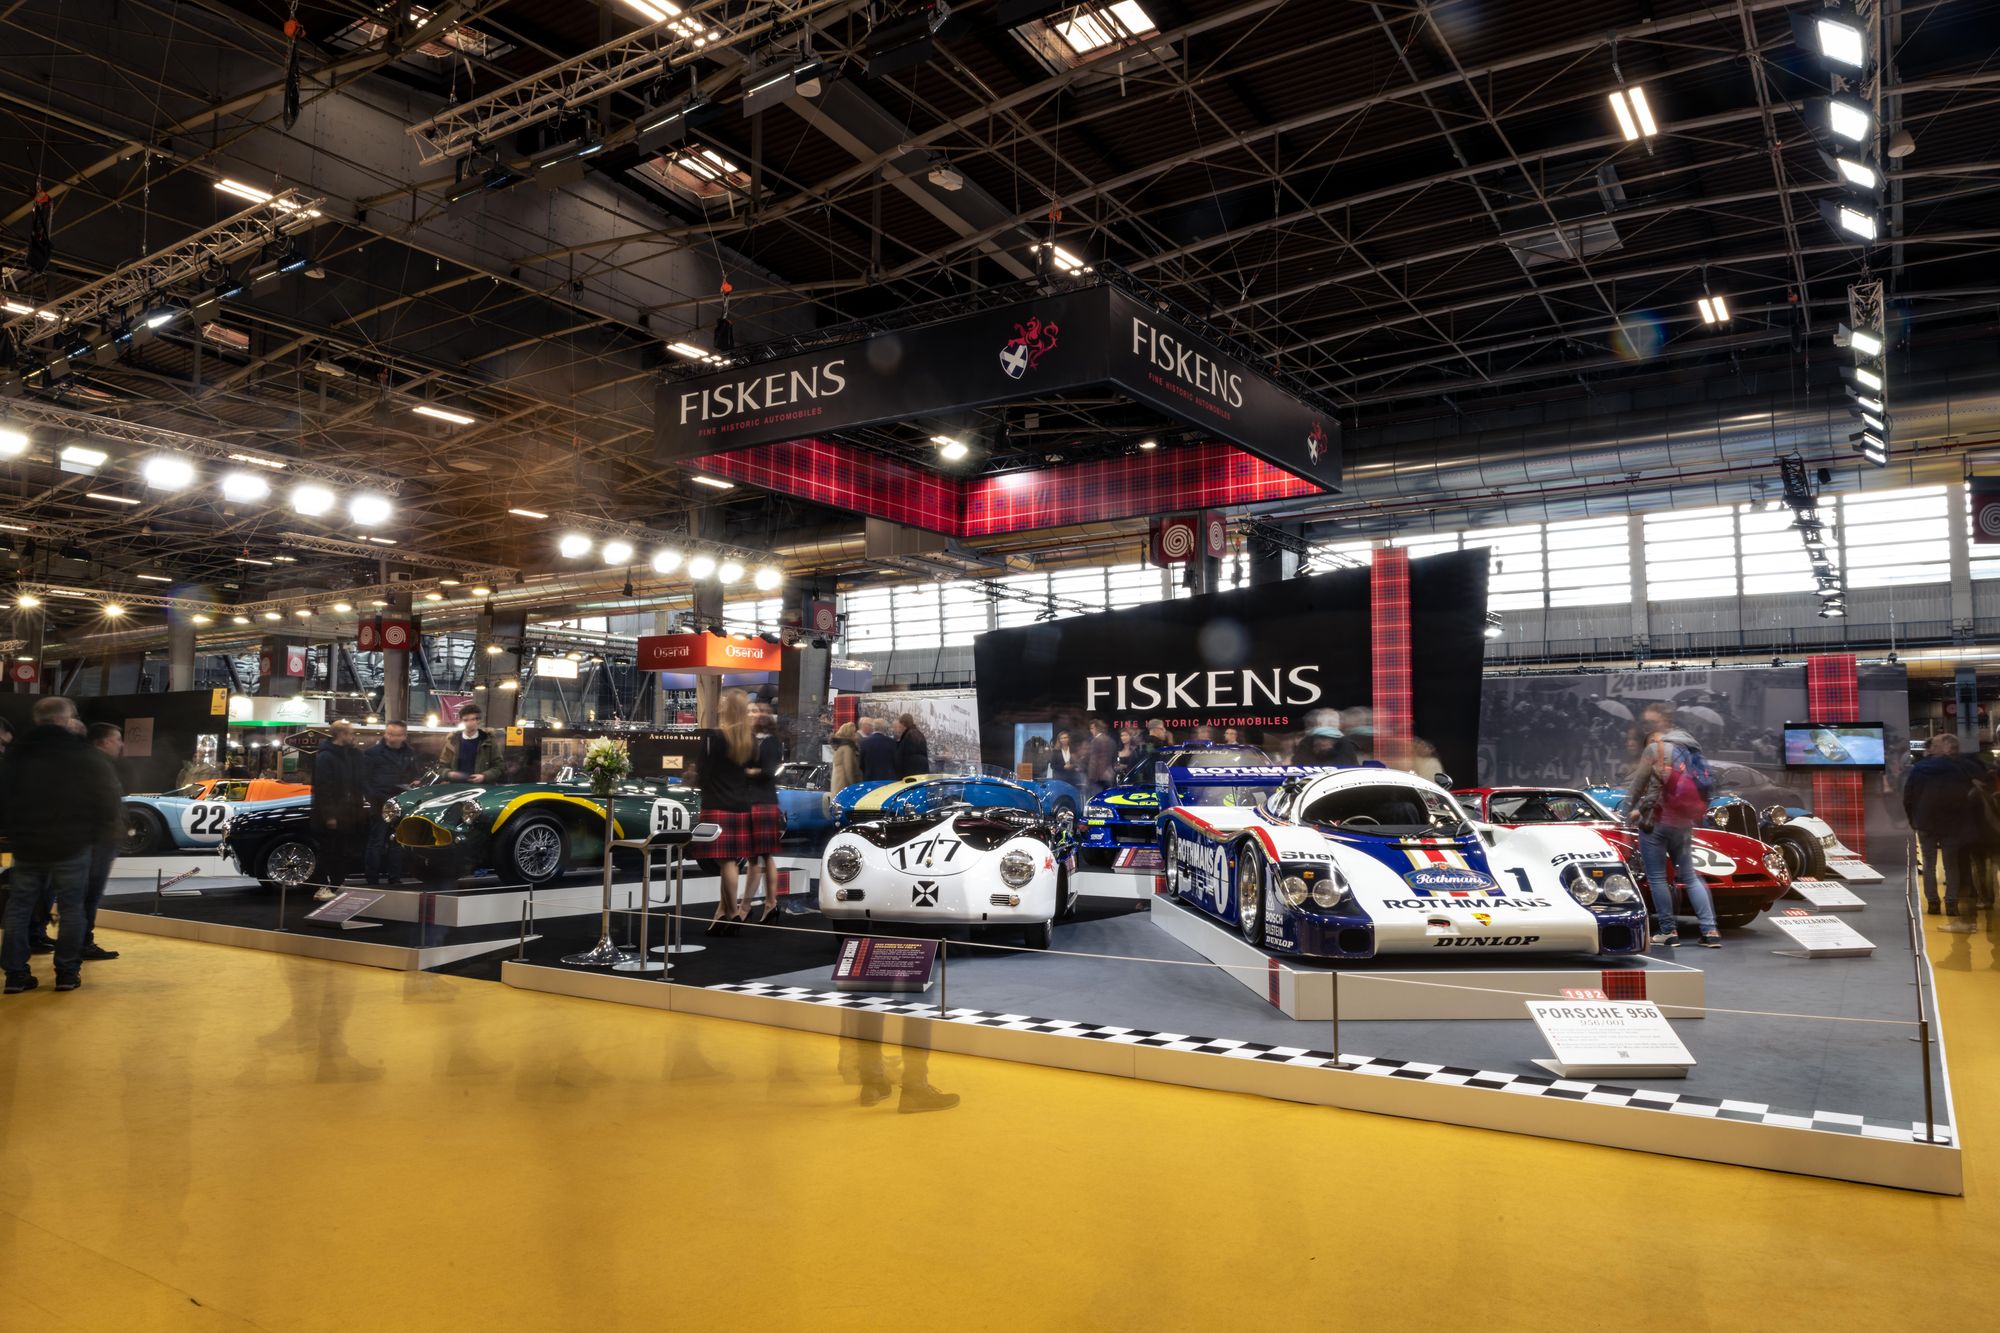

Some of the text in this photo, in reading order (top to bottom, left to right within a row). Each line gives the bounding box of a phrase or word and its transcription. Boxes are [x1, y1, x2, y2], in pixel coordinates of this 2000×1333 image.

[1133, 317, 1243, 408] FISKENS
[680, 359, 846, 424] FISKENS
[698, 407, 823, 436] FINE HISTORIC AUTOMOBILES
[653, 646, 689, 659] Osenat
[726, 644, 764, 659] Osenat
[1086, 665, 1322, 711] FISKENS
[1612, 674, 1635, 693] 24
[1113, 720, 1139, 729] FINE
[1206, 716, 1289, 727] AUTOMOBILES
[649, 733, 701, 741] Auction house
[1187, 766, 1338, 774] ROTHMANS
[190, 805, 226, 835] 22
[657, 805, 683, 831] 59
[892, 839, 962, 870] 177
[1550, 850, 1614, 867] Shell
[1416, 873, 1488, 885] Rothmans
[1504, 867, 1534, 893] 1
[1382, 898, 1552, 909] ROTHMANS
[1266, 912, 1284, 925] BOSCH
[1266, 936, 1294, 948] DUNLOP
[1434, 936, 1540, 947] DUNLOP
[1566, 990, 1604, 1000] 1982
[1537, 1007, 1658, 1019] PORSCHE 956
